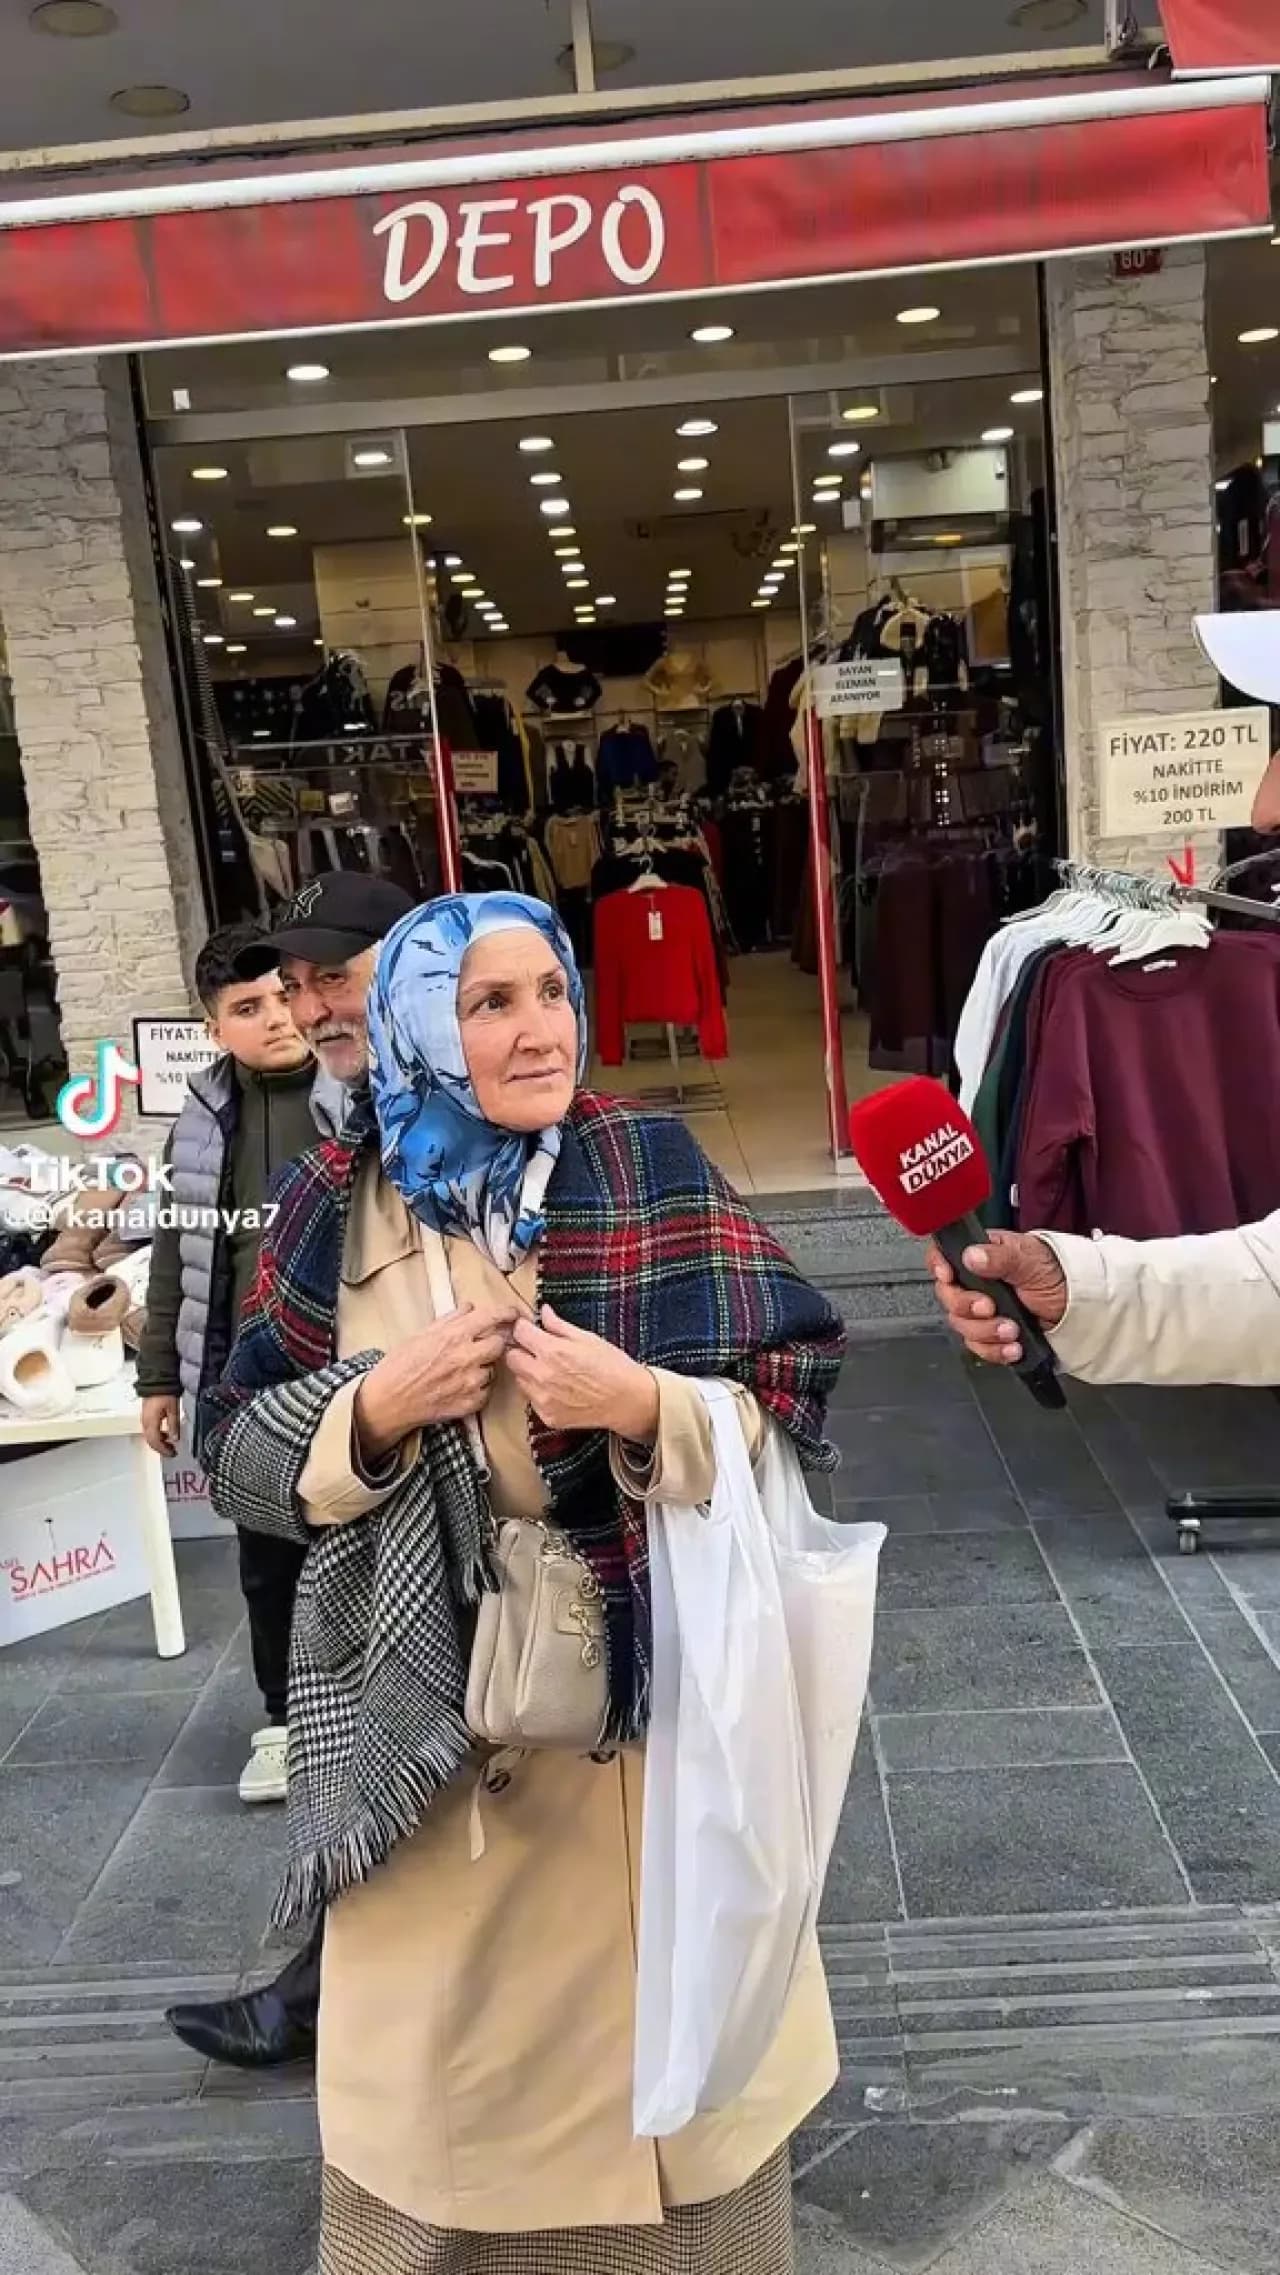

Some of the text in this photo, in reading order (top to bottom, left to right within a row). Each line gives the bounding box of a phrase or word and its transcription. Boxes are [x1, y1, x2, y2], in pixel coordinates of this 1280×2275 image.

[373, 185, 665, 302] DEPO
[1110, 724, 1259, 757] FİYAT: 220 TL
[1152, 757, 1224, 779] NAKİTTE
[1132, 780, 1243, 805] %10 İNDİRİM
[1162, 807, 1216, 825] 200 TL
[150, 1024, 199, 1041] FİYAT:
[899, 1121, 959, 1170] KANAL
[907, 1139, 971, 1190] DÜNYA
[10, 1538, 115, 1594] SAHRA
